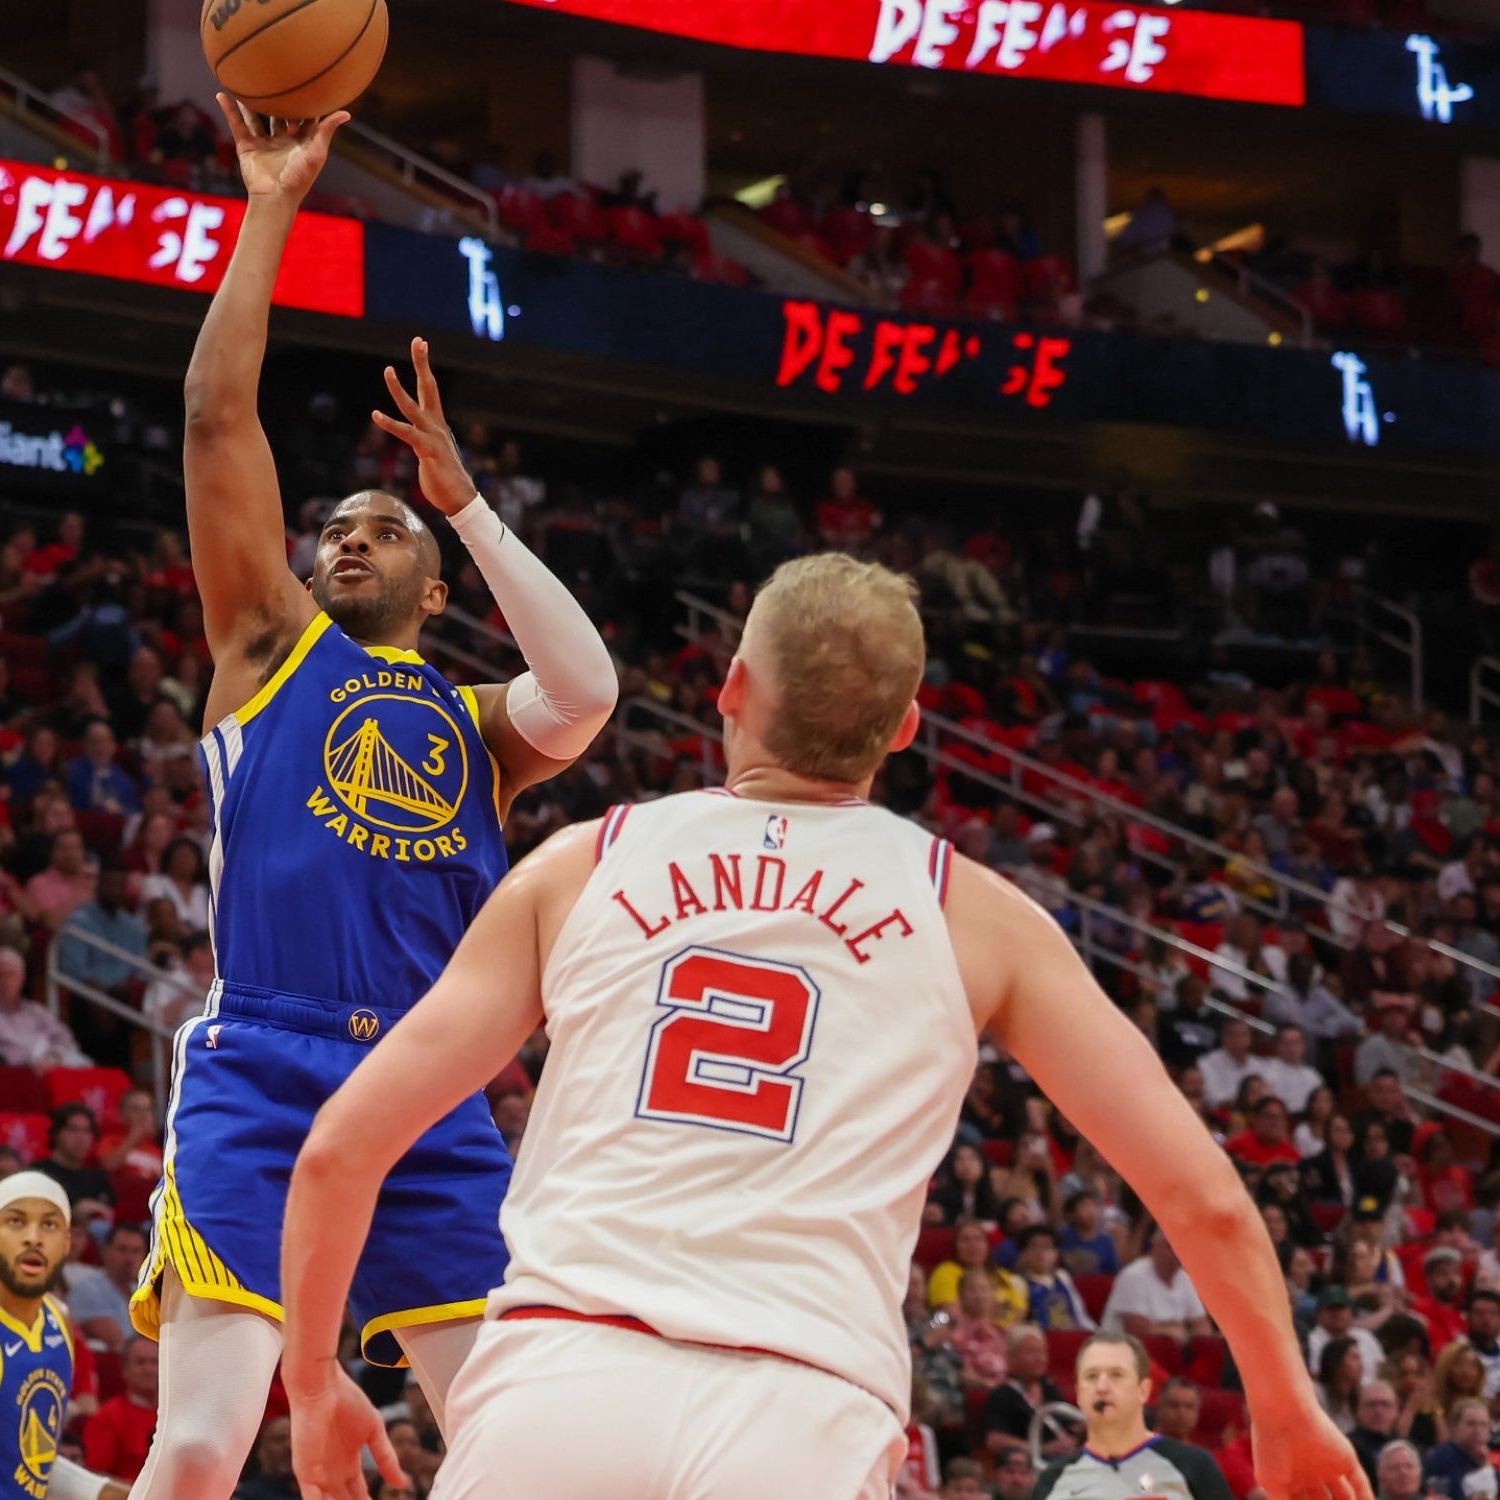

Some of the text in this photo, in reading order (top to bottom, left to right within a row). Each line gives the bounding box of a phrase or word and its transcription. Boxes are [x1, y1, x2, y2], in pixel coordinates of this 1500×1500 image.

[329, 671, 423, 703] GOLDEN
[421, 732, 450, 777] 3
[306, 784, 468, 862] WARRIORS
[611, 852, 915, 966] LANDALE
[633, 944, 821, 1144] 2
